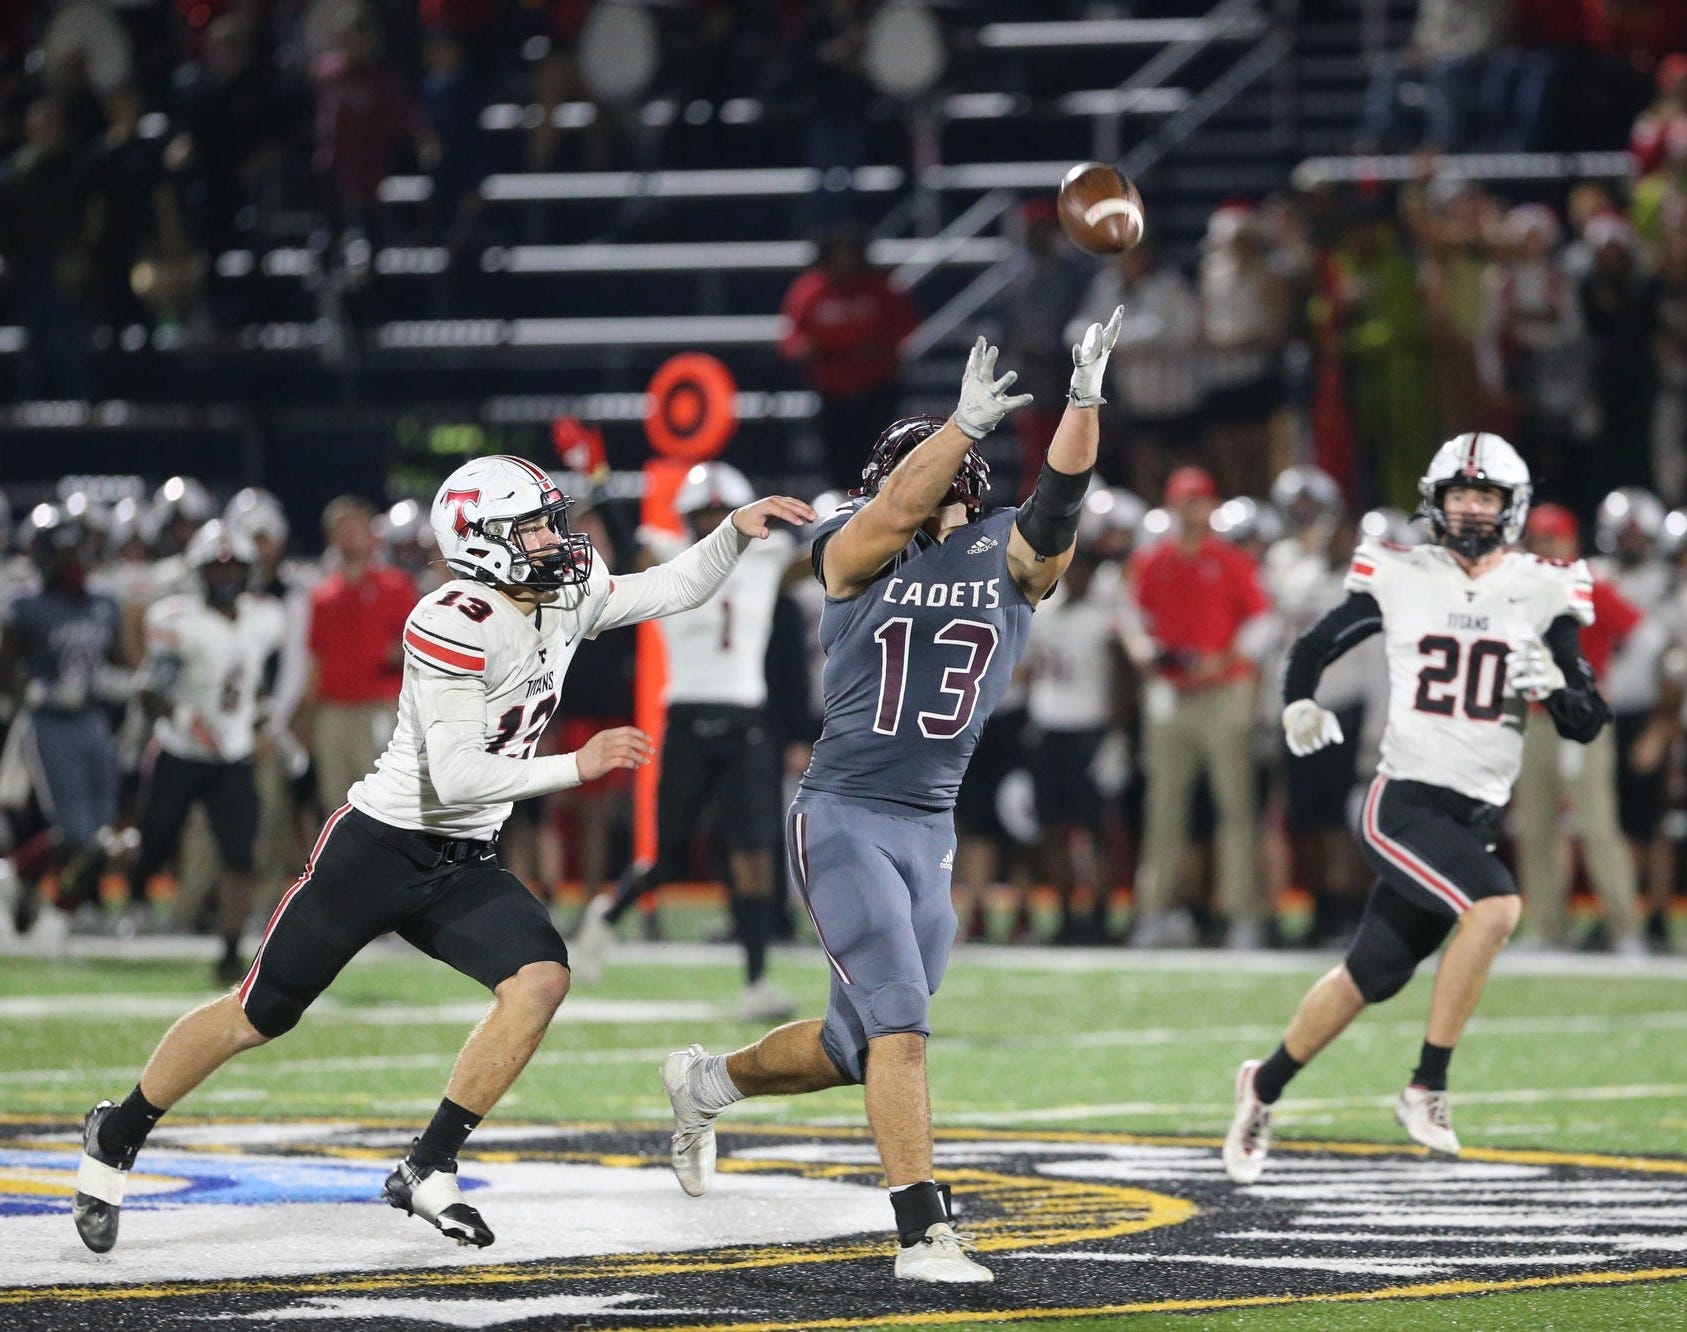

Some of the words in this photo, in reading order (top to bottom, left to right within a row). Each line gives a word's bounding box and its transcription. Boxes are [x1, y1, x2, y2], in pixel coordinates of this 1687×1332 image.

[435, 590, 494, 623] 13
[883, 577, 1000, 609] CADETS
[525, 670, 554, 699] TITANS
[873, 616, 999, 739] 13
[1413, 633, 1512, 722] 20
